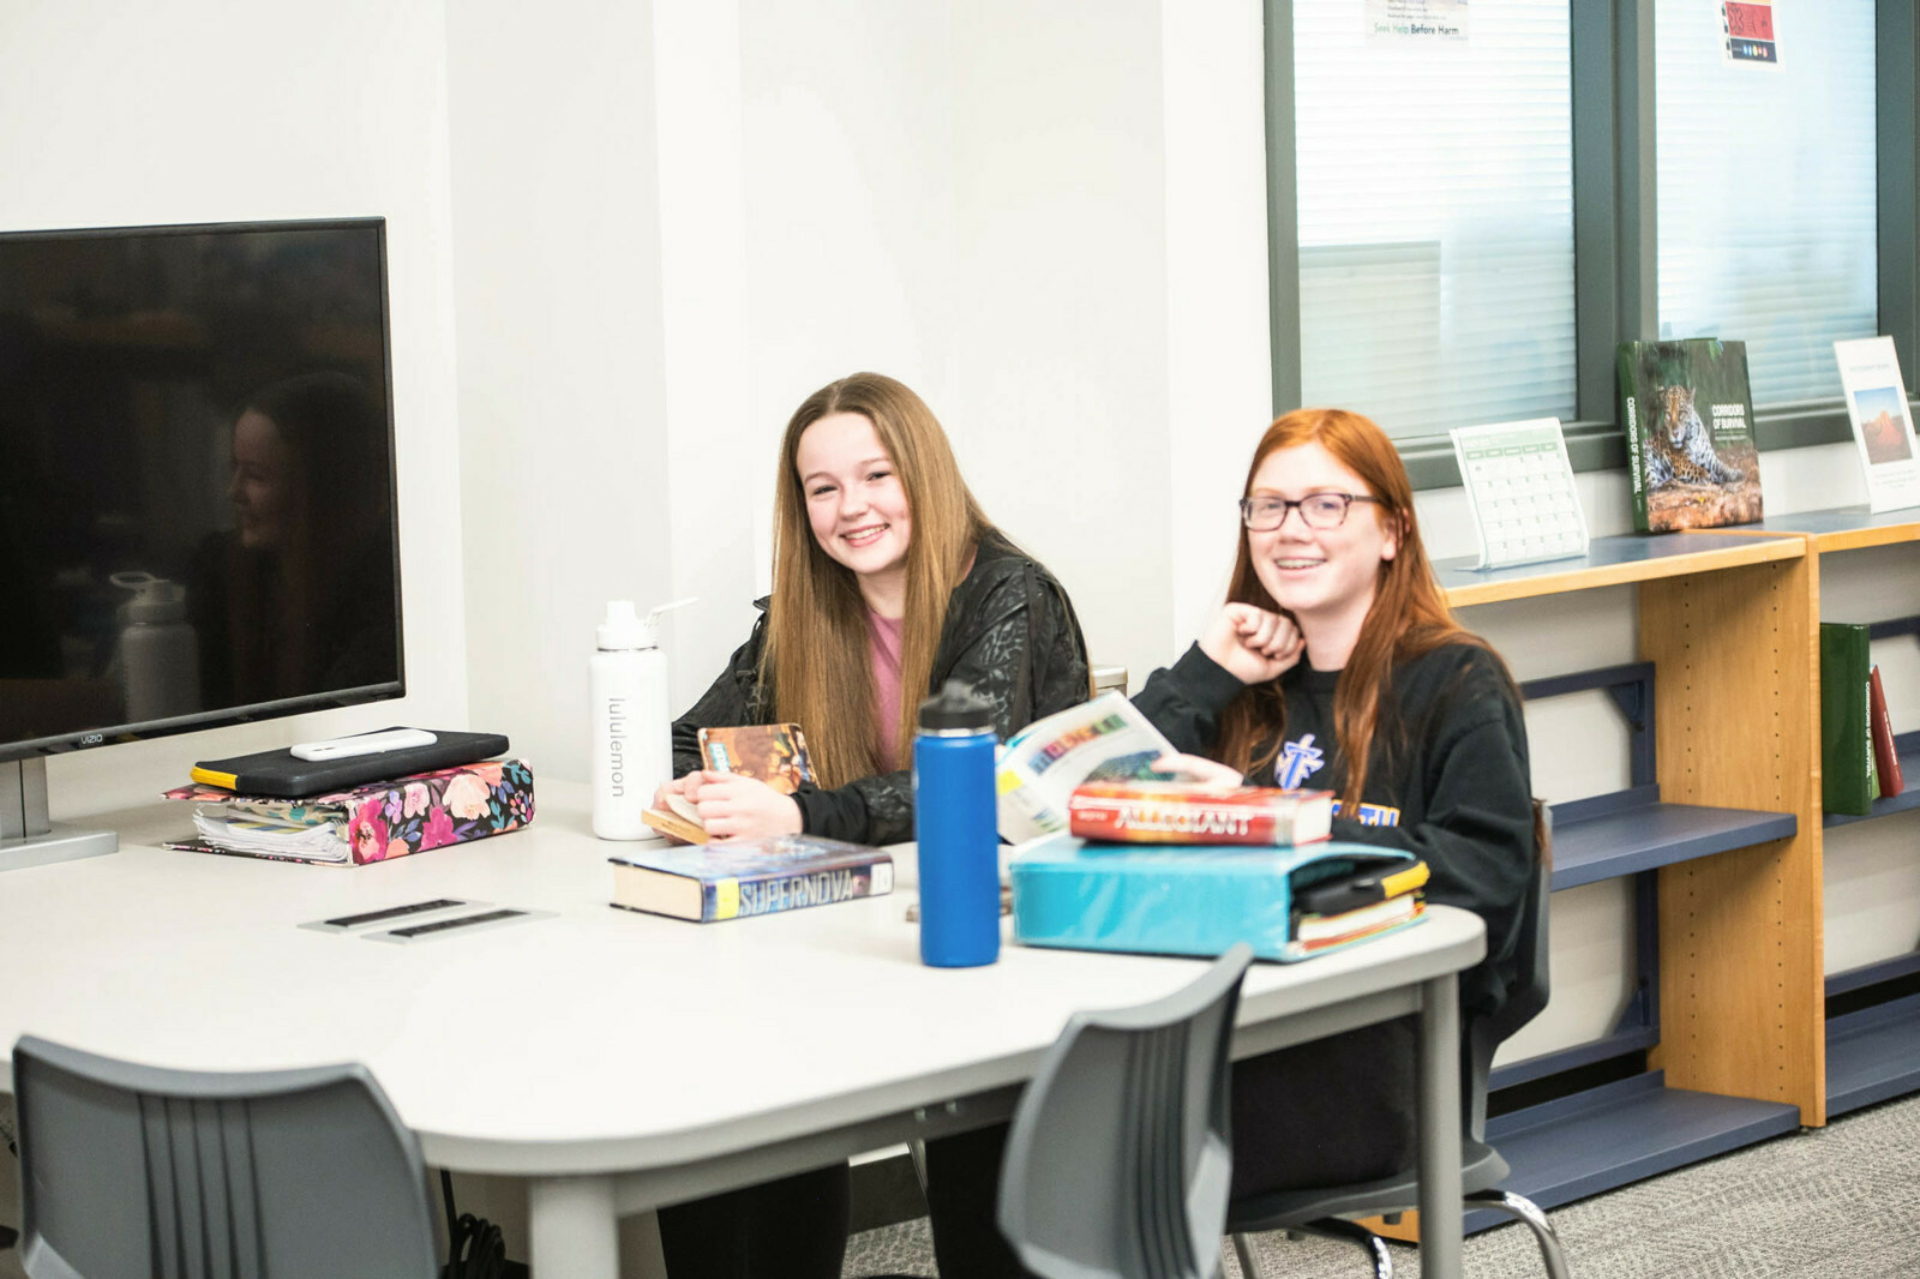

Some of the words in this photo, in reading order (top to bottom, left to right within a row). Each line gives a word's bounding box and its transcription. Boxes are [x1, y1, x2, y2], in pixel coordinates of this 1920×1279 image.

[1411, 24, 1436, 35] Before
[1438, 25, 1459, 35] Harm
[1627, 397, 1638, 444] CORRIDORS
[1712, 403, 1745, 417] CORRIDORS
[1713, 418, 1722, 430] OF
[1722, 417, 1747, 429] SURVIVAL
[1631, 444, 1639, 455] OF
[1632, 455, 1642, 494] SURVIVAL
[81, 733, 103, 745] VIZIO
[608, 697, 628, 798] lululemon
[1114, 805, 1252, 836] ALLEGIANT
[739, 869, 853, 917] SUPERNOVA
